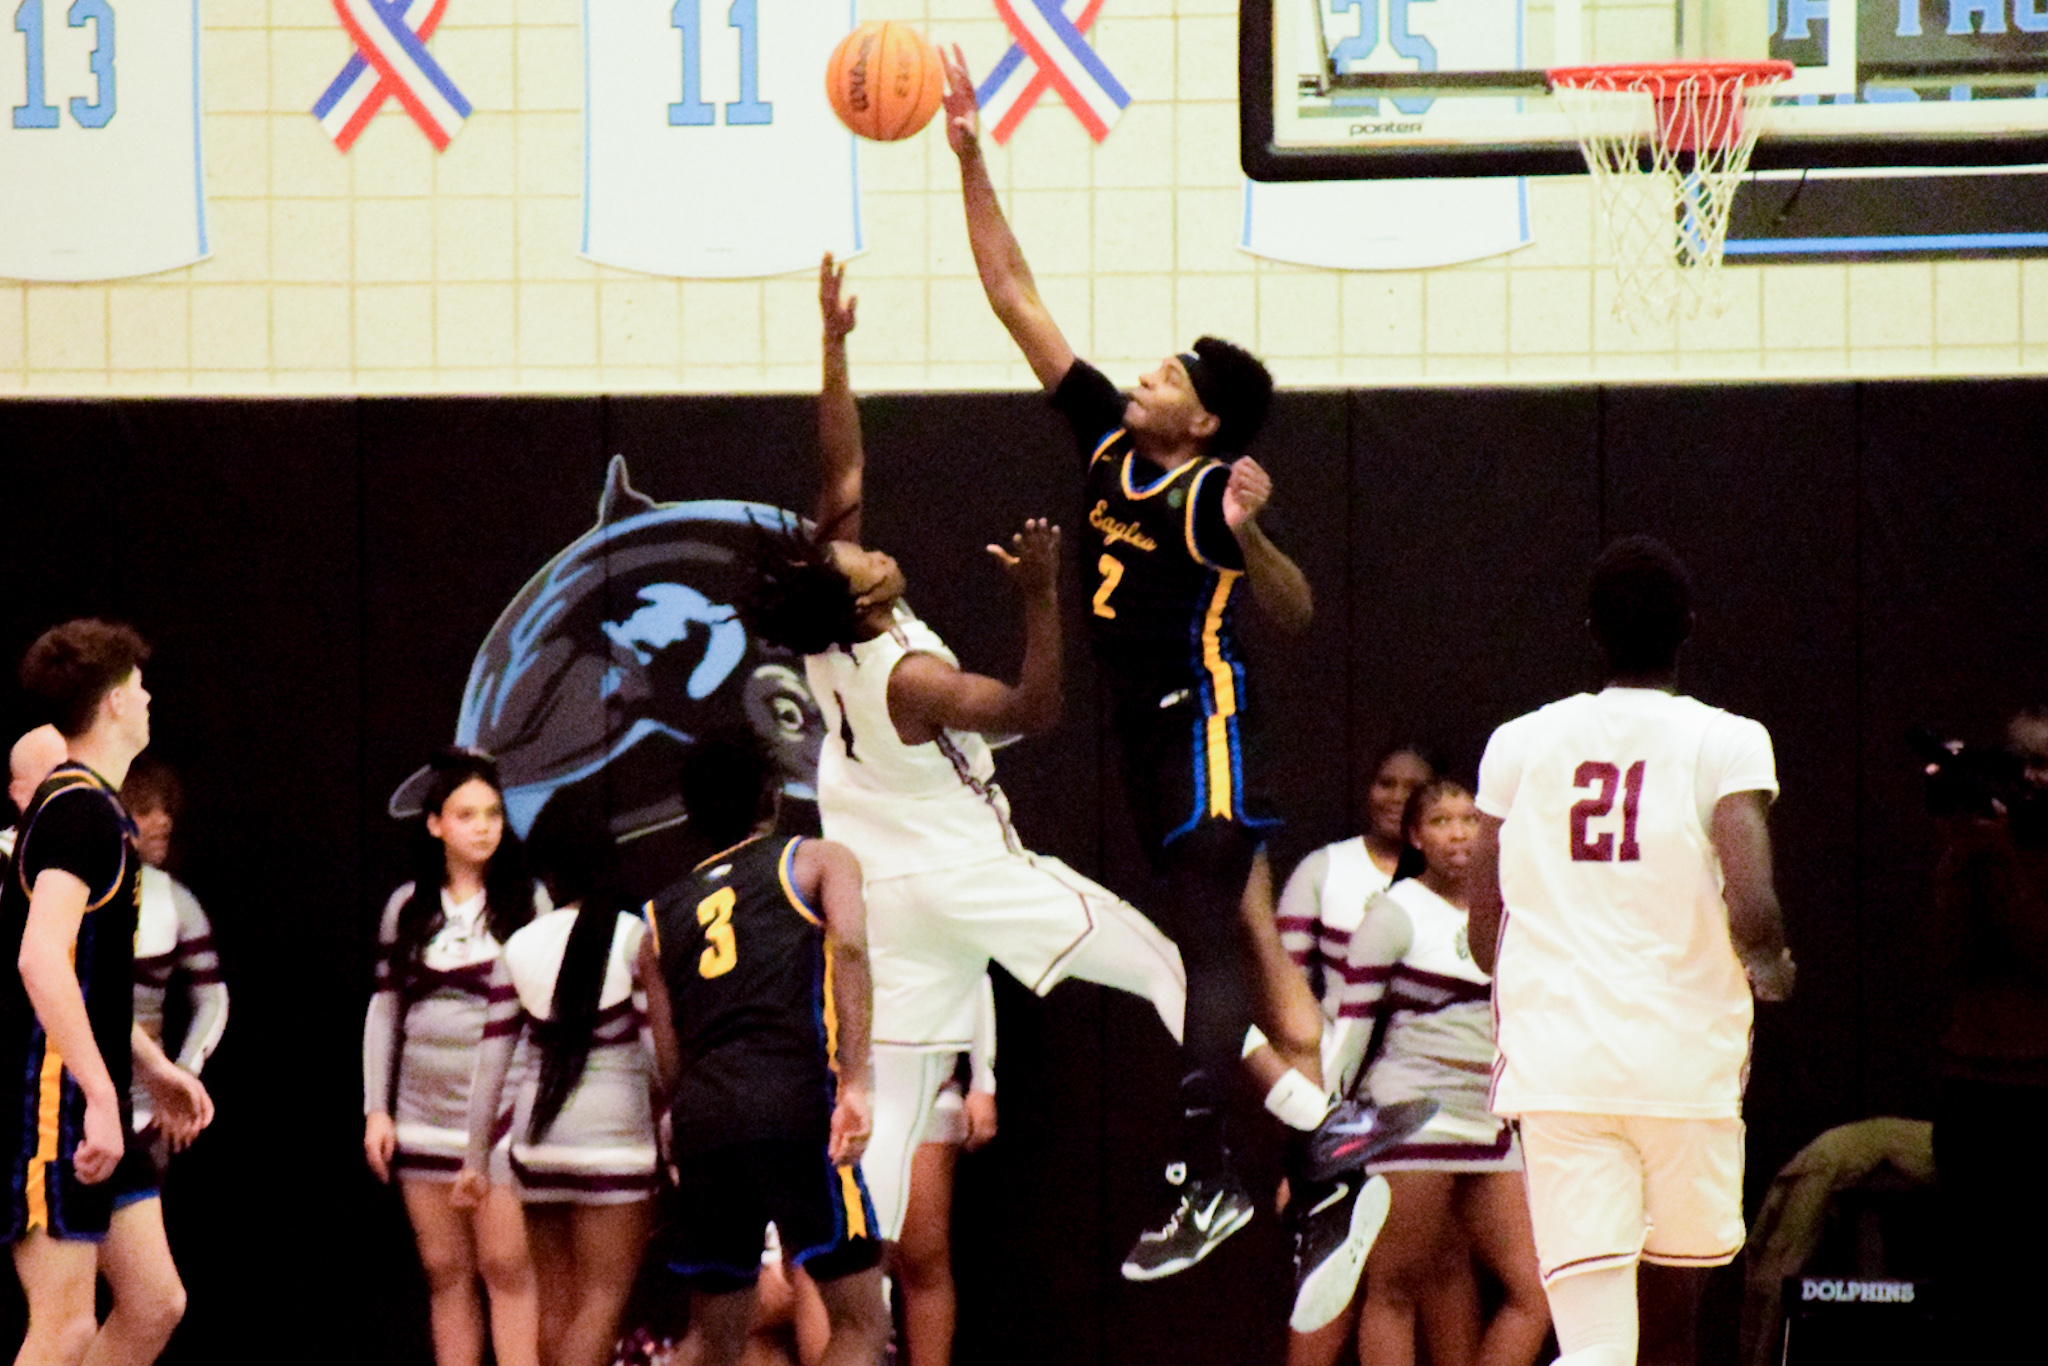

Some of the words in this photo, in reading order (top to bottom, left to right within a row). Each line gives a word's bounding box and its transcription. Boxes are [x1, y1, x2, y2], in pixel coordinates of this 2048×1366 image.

[12, 0, 117, 128] 13
[668, 0, 773, 126] 11
[1093, 553, 1125, 619] 2
[1570, 759, 1646, 862] 21
[696, 886, 738, 979] 3
[1801, 1278, 1915, 1303] DOLPHINS
